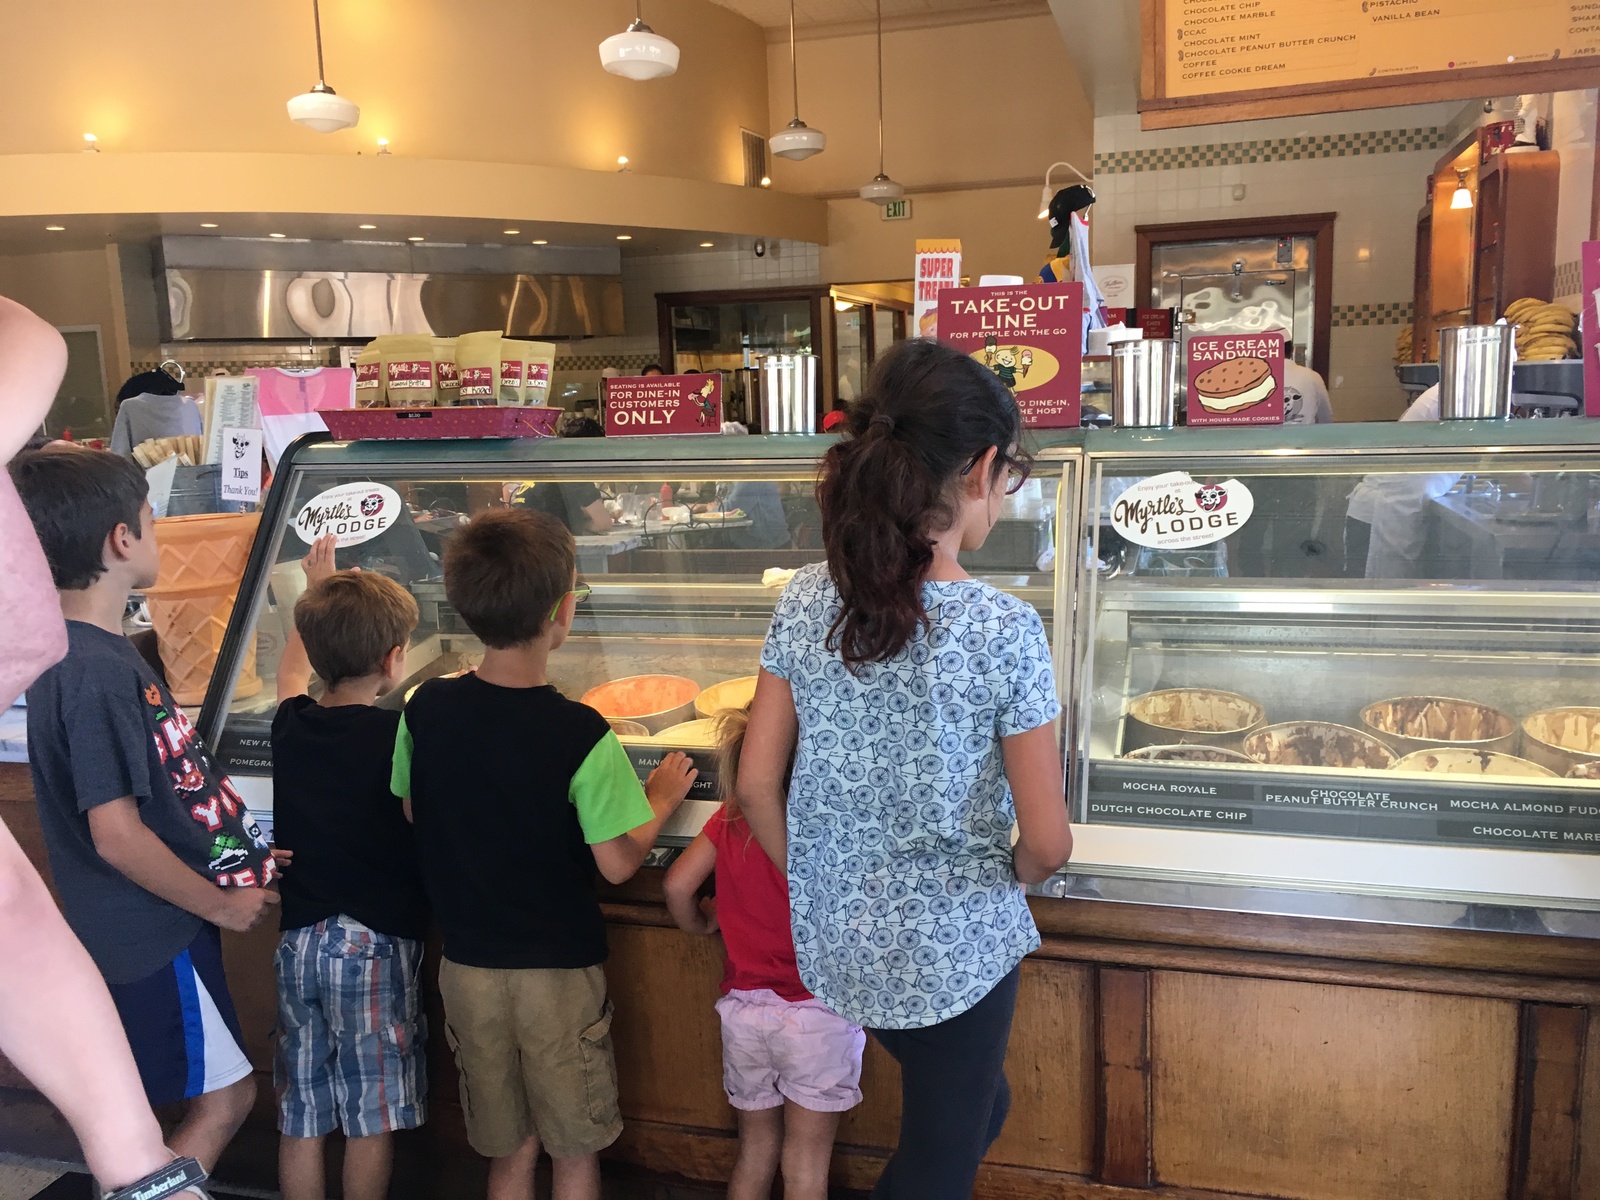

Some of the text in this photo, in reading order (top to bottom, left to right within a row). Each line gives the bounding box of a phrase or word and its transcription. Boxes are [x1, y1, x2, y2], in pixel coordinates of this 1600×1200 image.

[1183, 1, 1261, 16] CHOCOLATE CHIP
[1183, 10, 1276, 26] CHOCOLATE MARBLE
[1372, 9, 1440, 22] VANILLA BEAN
[1183, 28, 1207, 37] CCAC
[1568, 25, 1600, 34] CONTA
[1183, 33, 1261, 47] CHOCOLATE MINT
[1184, 34, 1357, 58] CHOCOLATE PEANUT BUTTER CRUNCH
[1182, 60, 1217, 69] COFFEE
[1182, 63, 1286, 80] COFFEE COOKIE DREAM
[886, 200, 906, 217] EXIT
[920, 258, 953, 278] SUPER
[951, 295, 1069, 315] TAKE-OUT
[981, 313, 1037, 330] LINE
[972, 330, 1010, 338] PEOPLE
[1193, 339, 1280, 351] ICE CREAM
[1193, 349, 1279, 361] SANDWICH
[610, 390, 680, 399] FOR DINE-IN
[610, 399, 680, 409] CUSTOMERS
[1029, 399, 1070, 407] DINE-IN,
[614, 410, 676, 425] ONLY
[1036, 407, 1063, 415] HOST
[233, 467, 248, 479] Tips
[223, 485, 259, 496] Thank You!
[345, 489, 364, 497] take-out
[298, 502, 358, 536] Myrtle's
[1114, 494, 1196, 534] Myrtle's
[326, 517, 387, 535] LODGE
[1156, 512, 1239, 535] LODGE
[1180, 535, 1191, 543] the
[1192, 533, 1214, 541] street!
[229, 757, 273, 767] POMEGRA
[638, 758, 664, 766] MAN
[1122, 782, 1217, 795] MOCHA ROYALE
[1311, 789, 1390, 801] CHOCOLATE
[1265, 794, 1438, 811] PEANUT BUTTER CRUNCH
[1450, 800, 1500, 810] MOCHA
[1504, 802, 1564, 814] ALMOND
[1091, 804, 1248, 820] DUTCH CHOCOLATE CHIP
[1473, 826, 1600, 842] CHOCOLATE MARB
[131, 1169, 187, 1200] Timberland
